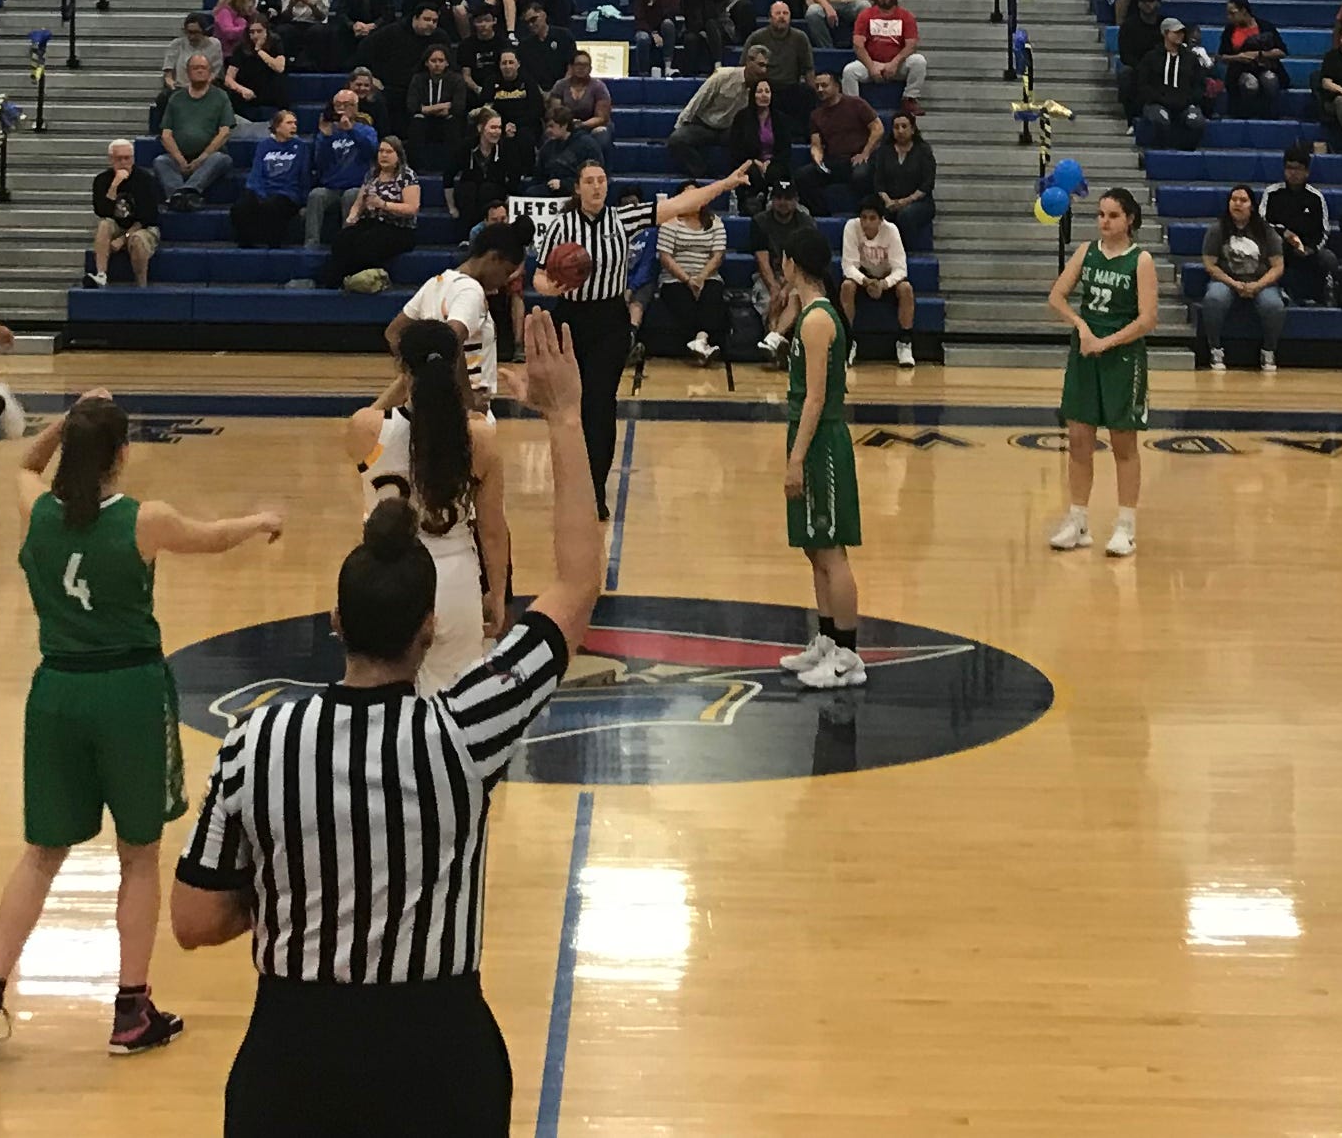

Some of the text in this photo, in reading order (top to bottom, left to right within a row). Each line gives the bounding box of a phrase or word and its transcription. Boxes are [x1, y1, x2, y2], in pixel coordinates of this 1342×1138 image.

[513, 201, 558, 216] LETS
[1095, 268, 1132, 289] MARY'S
[1088, 286, 1113, 313] 22
[62, 552, 94, 612] 4
